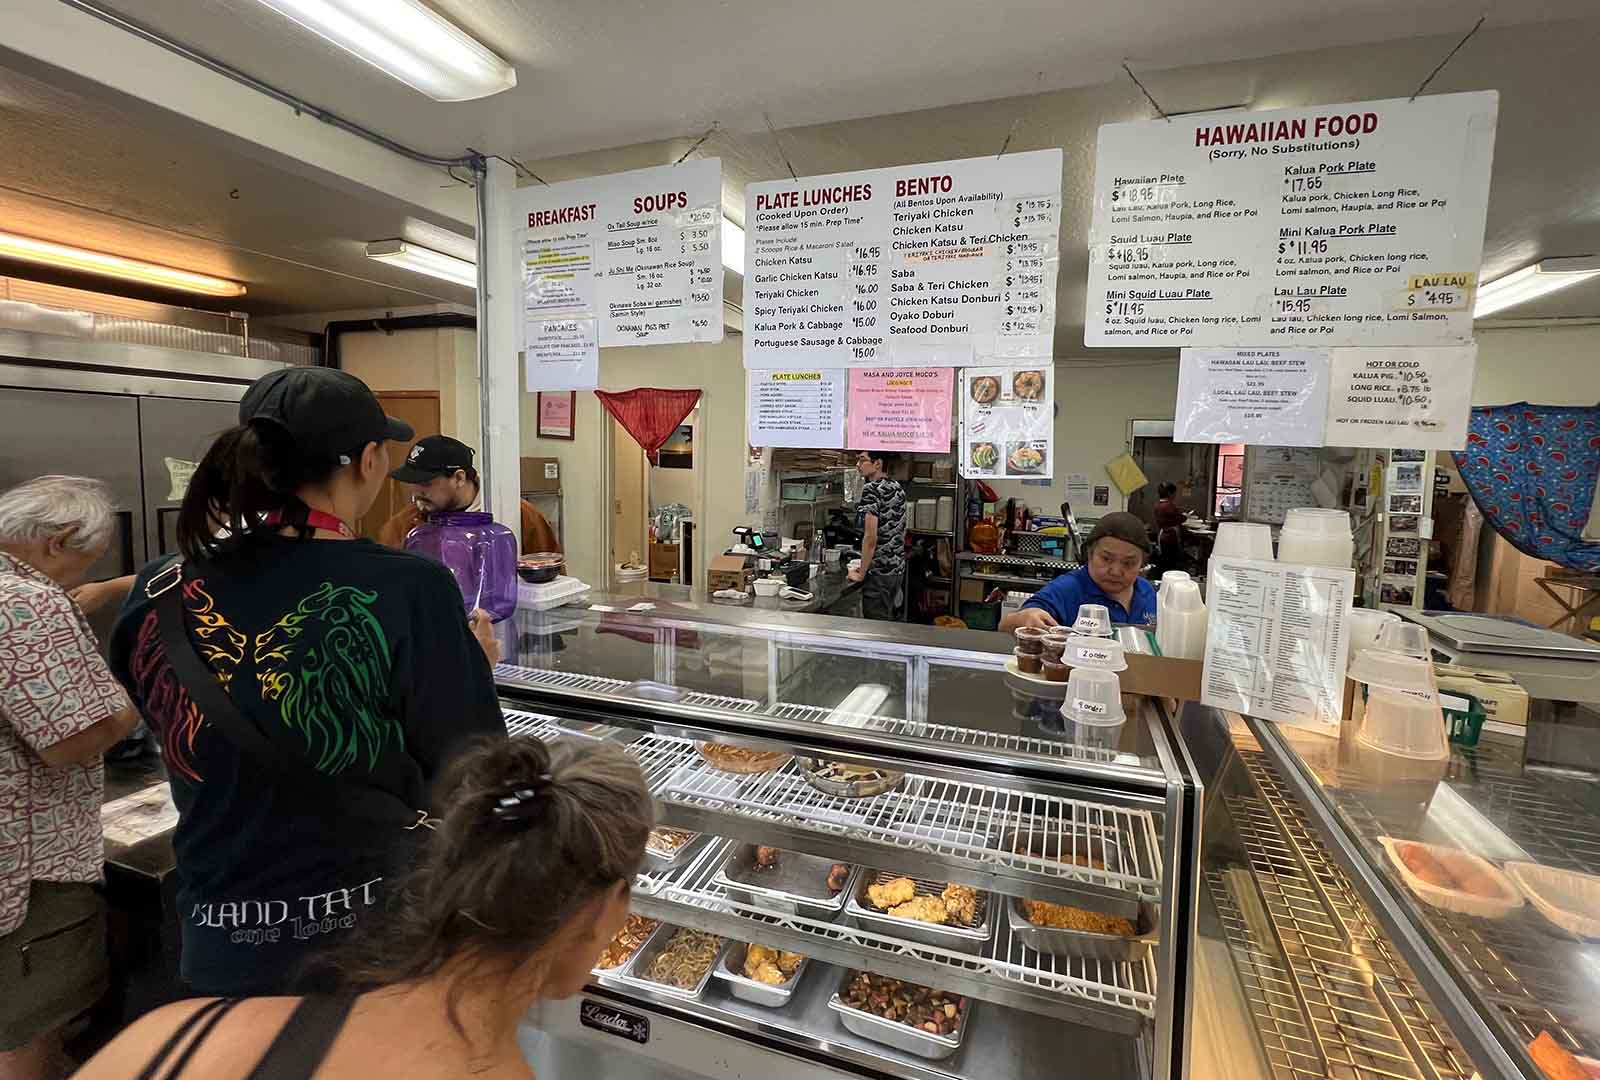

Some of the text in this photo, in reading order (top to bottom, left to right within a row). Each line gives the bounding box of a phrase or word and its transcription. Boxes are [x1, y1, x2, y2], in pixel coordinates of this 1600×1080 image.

[1196, 113, 1378, 146] HAWAIIAN FOOD
[1209, 138, 1360, 160] (Sorry, No Substitutions)
[1285, 162, 1376, 175] Kalua Pork Plate
[896, 175, 953, 197] BENTO
[1114, 174, 1184, 186] Hawaiian Plate
[634, 192, 688, 214] SOUPS
[756, 184, 872, 210] PLATE LUNCHES
[894, 200, 906, 209] (All
[936, 197, 956, 206] Upon
[958, 192, 1004, 203] Availability)
[528, 204, 596, 228] BREAKFAST
[756, 207, 848, 222] (Cooked Upon Order)
[894, 208, 974, 223] Teriyaki Chicken
[781, 222, 799, 230] allow
[826, 219, 842, 228] Prep
[892, 224, 963, 236] Chicken Katsu
[1280, 224, 1396, 238] Mini Kalua Pork Plate
[892, 233, 1028, 250] Chicken Katsu & Teri Chicken
[1168, 233, 1192, 242] Plate
[806, 242, 834, 250] Macaroni
[836, 240, 853, 248] Salad
[856, 247, 880, 259] $16.95
[1350, 252, 1429, 262] Chicken long rice,
[755, 255, 812, 267] Chicken Katsu
[755, 270, 838, 283] Garlic Chicken Katsu
[891, 270, 915, 278] Saba
[1299, 268, 1331, 276] salmon,
[1353, 266, 1372, 274] Rice
[1386, 265, 1401, 273] Poi
[891, 280, 989, 292] Saba & Teri Chicken
[1414, 276, 1466, 289] LAU LAU
[755, 289, 819, 300] Teriyaki Chicken
[1107, 289, 1210, 300] Mini Squid Luau Plate
[1274, 285, 1347, 296] Lau Lau Plate
[890, 295, 1000, 306] Chicken Katsu Donburi
[754, 304, 843, 316] Spicy Teriyaki Chicken
[890, 310, 954, 322] Oyako Doburi
[754, 320, 843, 331] Kalua Pork & Cabbage
[889, 324, 968, 334] Seafood Donburi
[754, 339, 798, 349] Portuguese
[800, 338, 835, 347] Sausage
[846, 336, 883, 346] Cabbage
